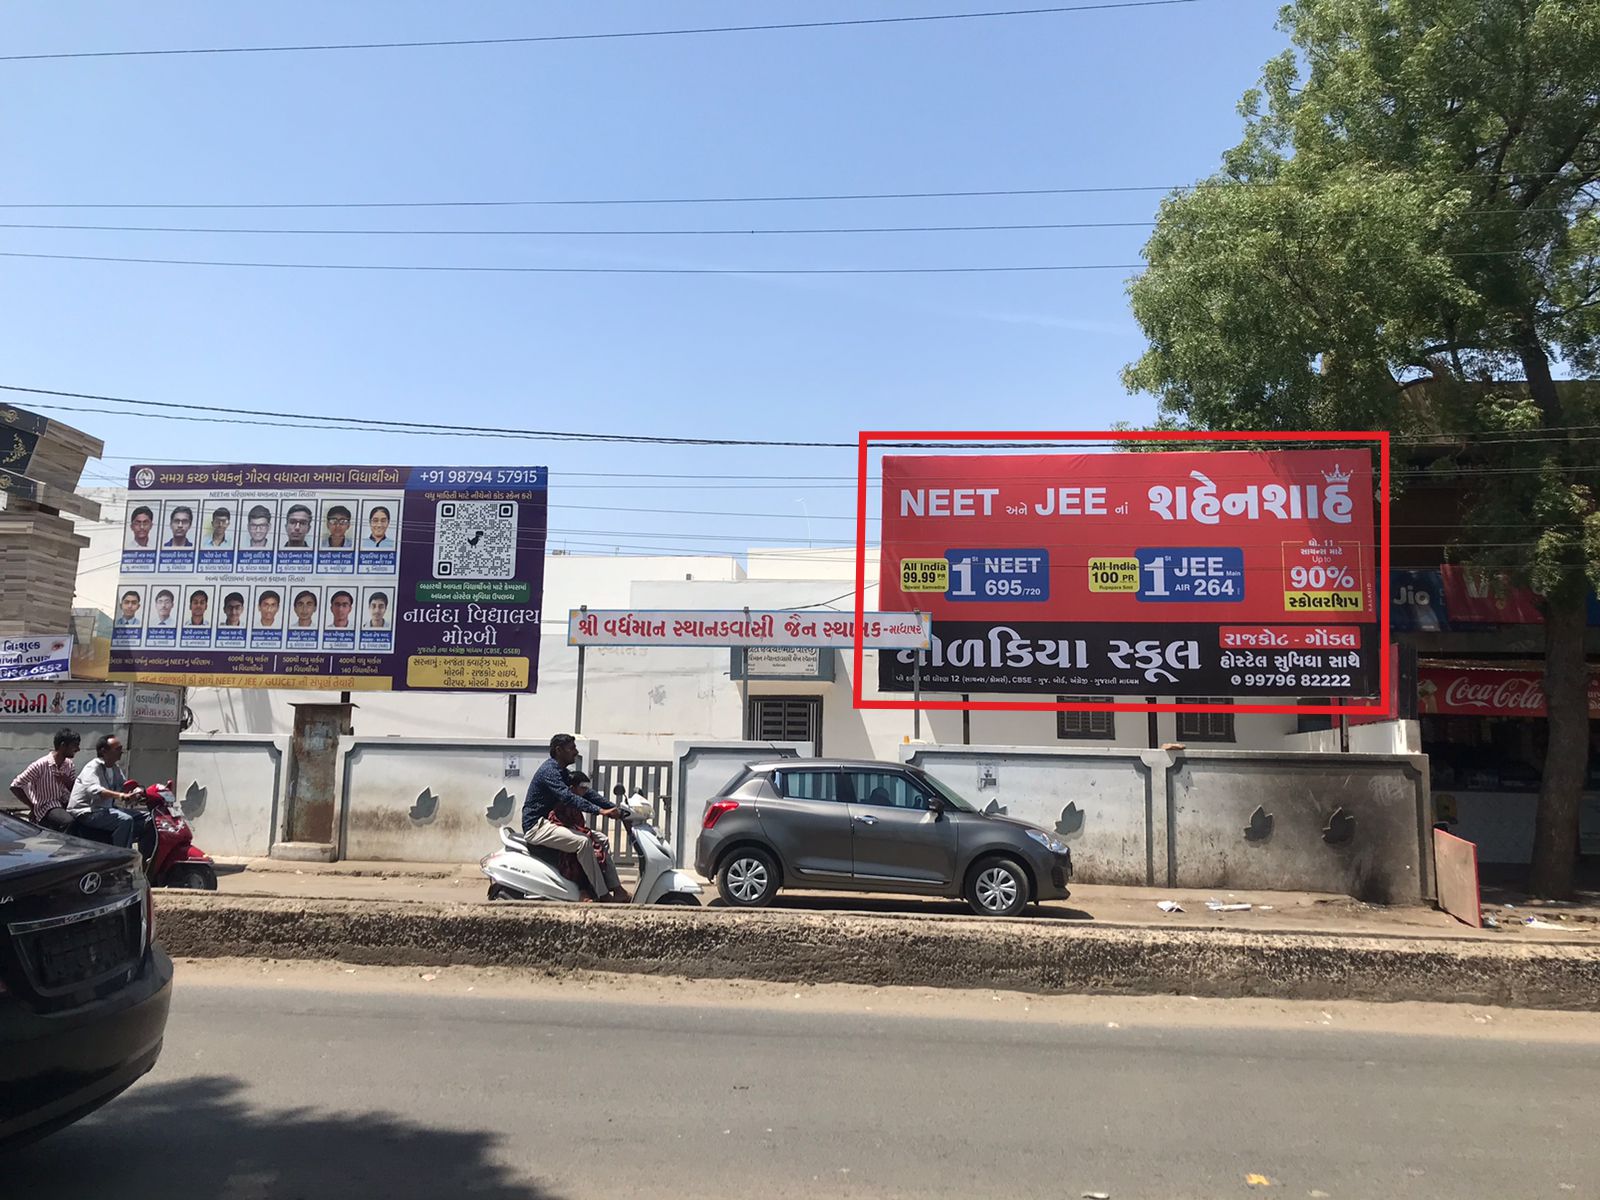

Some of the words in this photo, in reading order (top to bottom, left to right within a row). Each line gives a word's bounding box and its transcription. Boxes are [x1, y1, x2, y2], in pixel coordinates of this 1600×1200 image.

[160, 473, 183, 484] સમગ્ર
[187, 473, 208, 484] કચ્છ
[212, 470, 242, 486] પંથકનું
[245, 468, 270, 484] ગૌરવ
[273, 471, 309, 483] વધારતા
[314, 471, 345, 483] અમારા
[420, 470, 444, 483] +91
[448, 470, 492, 483] 98794
[497, 470, 537, 483] 57915
[458, 490, 469, 499] માટે
[521, 490, 532, 499] કરો
[900, 488, 999, 517] NEET
[1006, 502, 1028, 516] અને
[1035, 487, 1108, 516] JEE
[1114, 502, 1129, 515] નાં
[1148, 470, 1353, 525] શહેનશાહ
[1312, 555, 1323, 564] Up
[1329, 547, 1343, 555] માટે
[903, 562, 917, 571] All
[920, 562, 946, 571] India
[984, 557, 1041, 574] NEET
[1092, 562, 1106, 571] All
[1109, 562, 1137, 571] India
[1174, 556, 1224, 577] JEE
[903, 571, 936, 583] 99.99
[1092, 571, 1119, 583] 100
[1290, 565, 1355, 589] 90%
[1193, 578, 1235, 596] 264
[1393, 585, 1430, 606] Jio
[1289, 592, 1359, 608] સ્કોલરશિપ
[403, 604, 459, 623] નાલંદા
[467, 603, 539, 624] વિદ્યાલય
[578, 613, 598, 637] શ્રી
[604, 613, 666, 637] વર્ધમાન
[673, 614, 774, 638] સ્થાનકવાસી
[784, 614, 816, 638] જૈન
[442, 625, 497, 645] મોરબી
[1224, 628, 1289, 646] રાજકોટ
[1305, 628, 1355, 646] ગોંડલ
[1108, 640, 1202, 683] સ્કૂલ
[1220, 650, 1267, 669] હોસ્ટેલ
[1274, 651, 1322, 673] સુવિધા
[1329, 651, 1360, 668] સાથે
[444, 667, 465, 677] મોરબી
[1012, 676, 1032, 684] CBSE
[1244, 674, 1296, 687] 99796
[1300, 674, 1351, 687] 82222
[215, 677, 236, 686] NEET
[468, 678, 488, 688] મોરબી
[1445, 676, 1543, 709] Coca-Cola
[66, 692, 117, 715] દાબેલી
